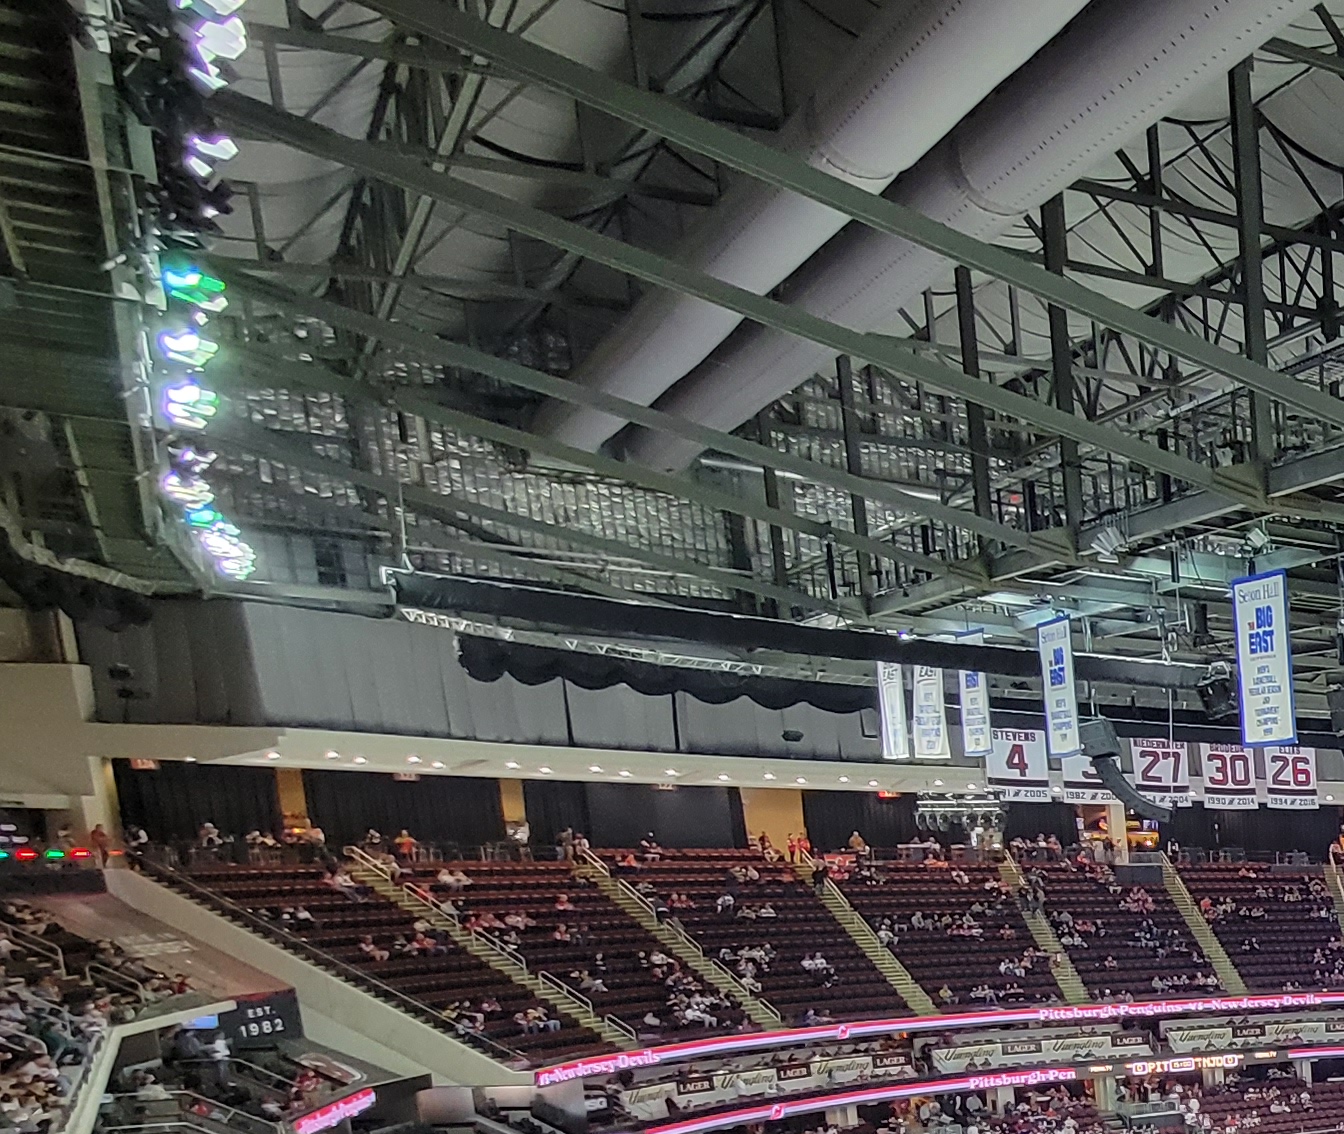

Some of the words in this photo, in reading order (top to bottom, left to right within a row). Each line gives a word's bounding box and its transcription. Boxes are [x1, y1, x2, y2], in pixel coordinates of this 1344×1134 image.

[1255, 605, 1272, 628] BIG
[1248, 630, 1274, 654] EAST
[993, 731, 1036, 742] STEVENS
[1006, 744, 1028, 777] 4
[1140, 751, 1180, 783] 27
[1207, 755, 1250, 786] 30
[1271, 756, 1310, 786] 26
[1066, 791, 1086, 799] 1982
[1208, 797, 1226, 805] 1990
[1237, 797, 1255, 805] 2014
[247, 1005, 276, 1018] EST.
[1040, 1006, 1118, 1020] Pittsburgh
[1120, 1002, 1182, 1016] Penguins
[1282, 994, 1321, 1006] Devils
[239, 1019, 285, 1038] 1982
[1236, 1027, 1264, 1037] LAGER
[1007, 1044, 1036, 1052] LAGER
[1117, 1037, 1143, 1045] LAGER
[618, 1051, 660, 1068] Devils
[780, 1068, 807, 1079] LAGER
[876, 1057, 905, 1067] LAGER
[1149, 1064, 1168, 1072] PIT
[1206, 1058, 1222, 1067] NJD
[969, 1073, 1043, 1089] Pittsburgh
[1048, 1070, 1076, 1080] Pen
